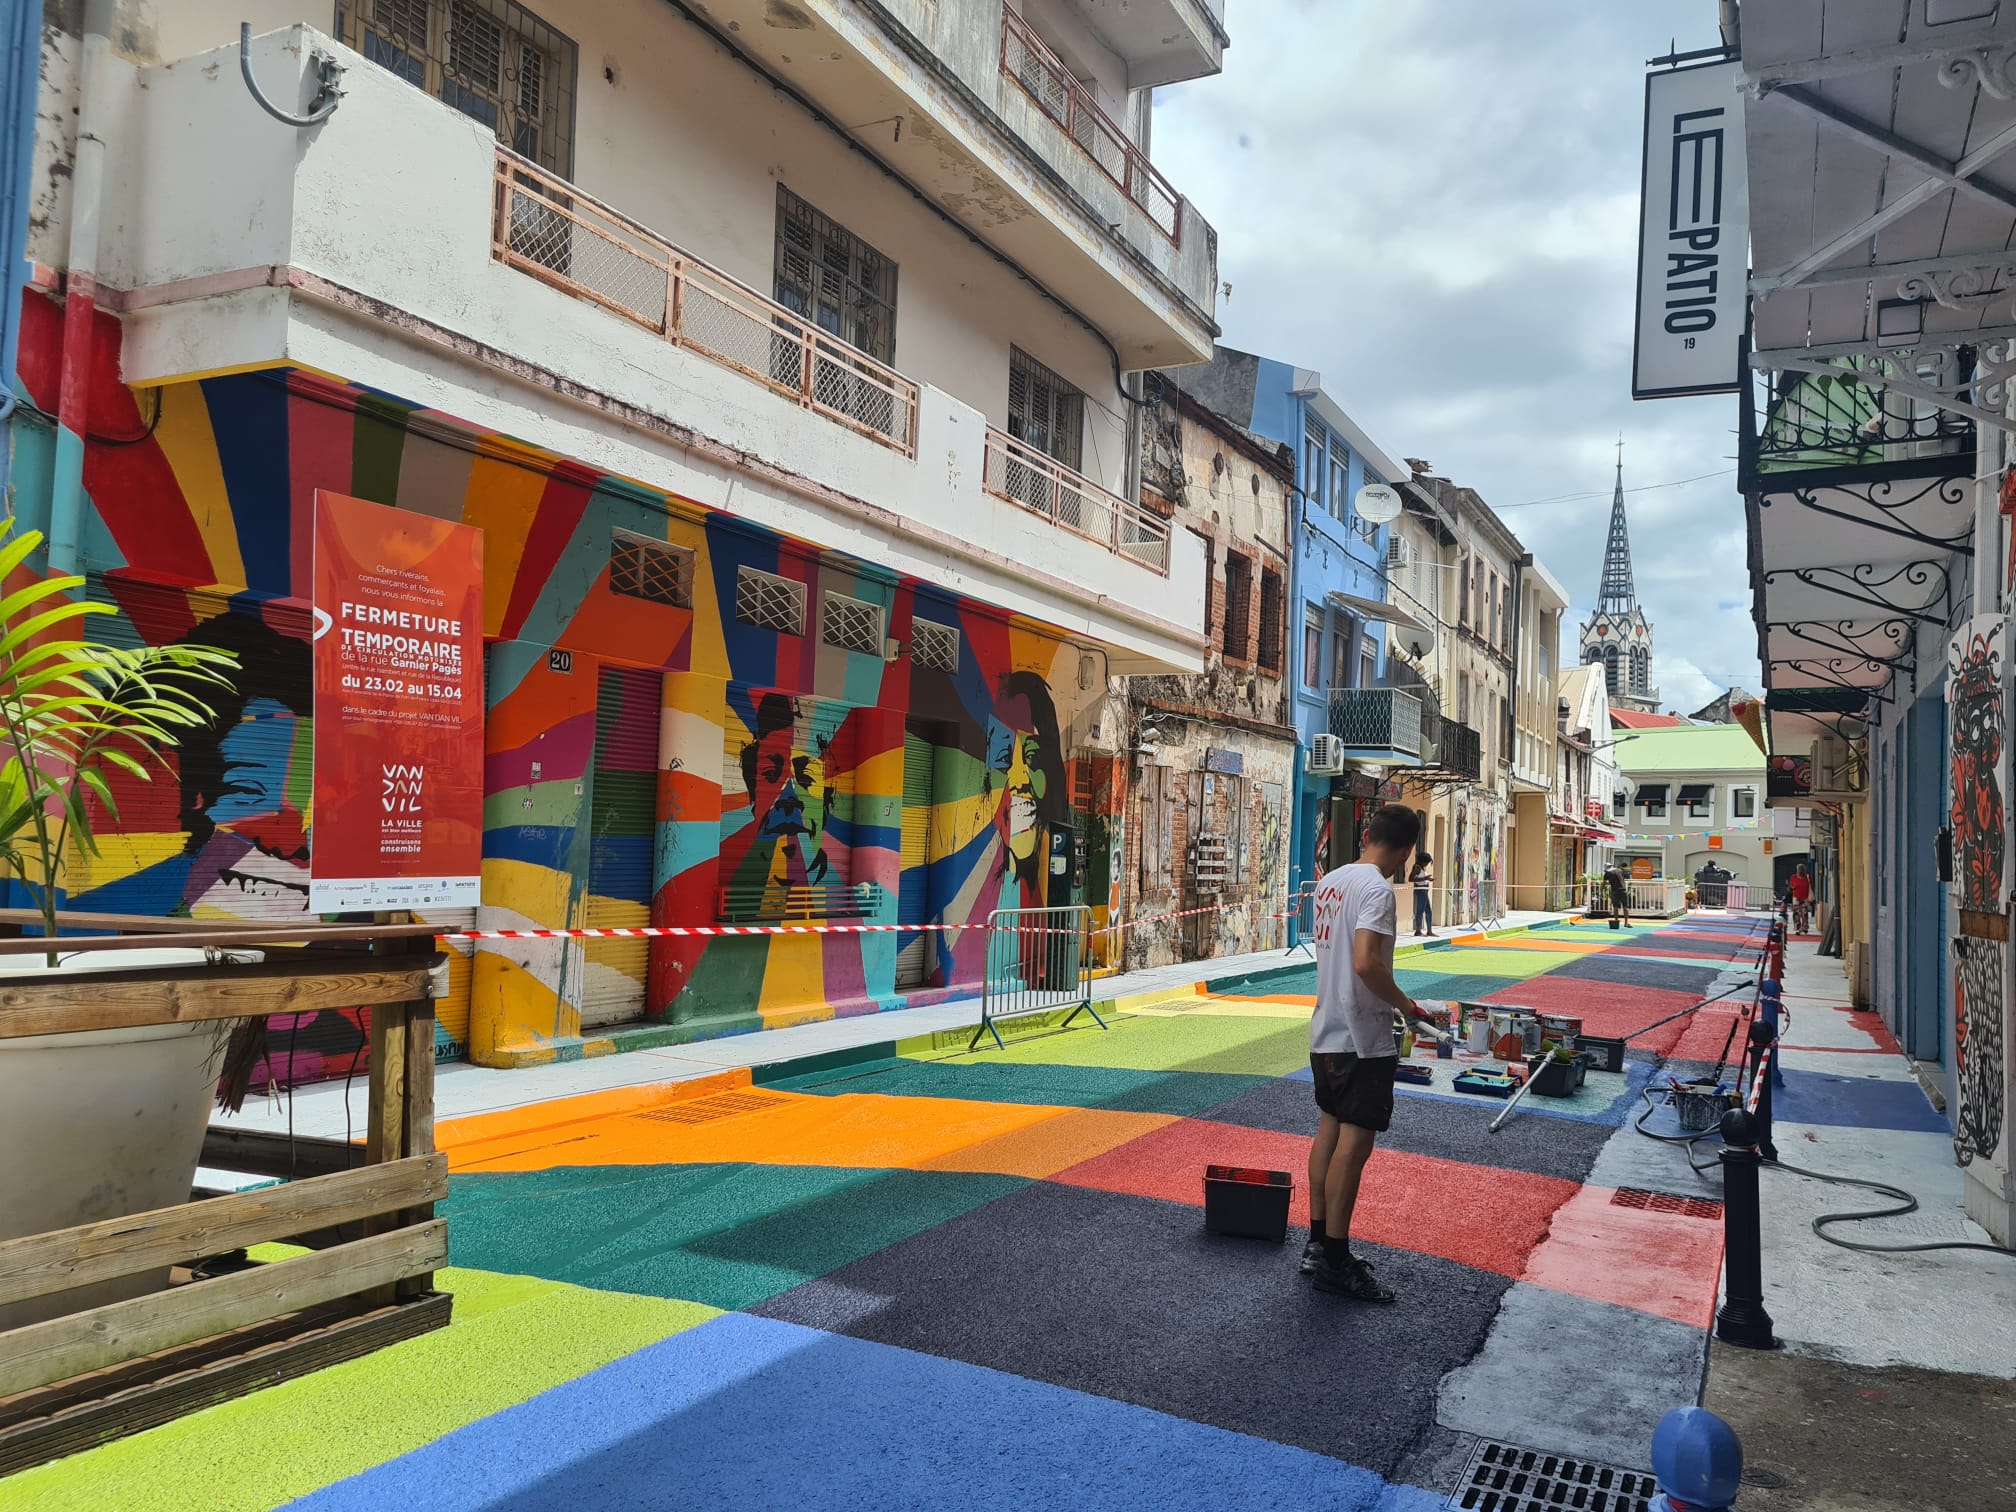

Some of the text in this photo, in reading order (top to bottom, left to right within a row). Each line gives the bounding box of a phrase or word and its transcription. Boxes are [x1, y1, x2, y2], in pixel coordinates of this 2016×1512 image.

[1664, 107, 1724, 334] LE PATIO
[1683, 338, 1695, 350] 19
[376, 564, 430, 582] Chers riverains,
[358, 574, 408, 590] commerçants
[409, 583, 417, 591] et
[361, 586, 380, 595] nous
[382, 590, 399, 599] vous
[400, 593, 435, 606] informons
[341, 601, 461, 636] FERMETURE
[341, 628, 461, 660] TEMPORAIRE
[341, 651, 355, 661] de
[359, 652, 368, 663] la
[371, 657, 388, 666] rue
[391, 657, 429, 671] Garnier
[357, 647, 414, 659] CIRCULATION
[551, 651, 569, 670] 20
[342, 673, 360, 688] du
[364, 676, 404, 693] 23.02
[407, 683, 424, 695] au
[427, 684, 462, 699] 15.04
[342, 705, 360, 714] dans
[361, 706, 367, 714] le
[367, 707, 388, 717] cadre
[389, 709, 397, 718] du
[398, 711, 418, 721] projet
[418, 712, 434, 721] VAN
[435, 714, 449, 722] DAN
[449, 715, 462, 724] VIL
[382, 763, 424, 780] VAN
[382, 779, 422, 796] DAN
[382, 796, 422, 812] VIL
[381, 819, 422, 828] LA VILLE
[380, 845, 421, 853] ensemble
[1053, 834, 1062, 850] P
